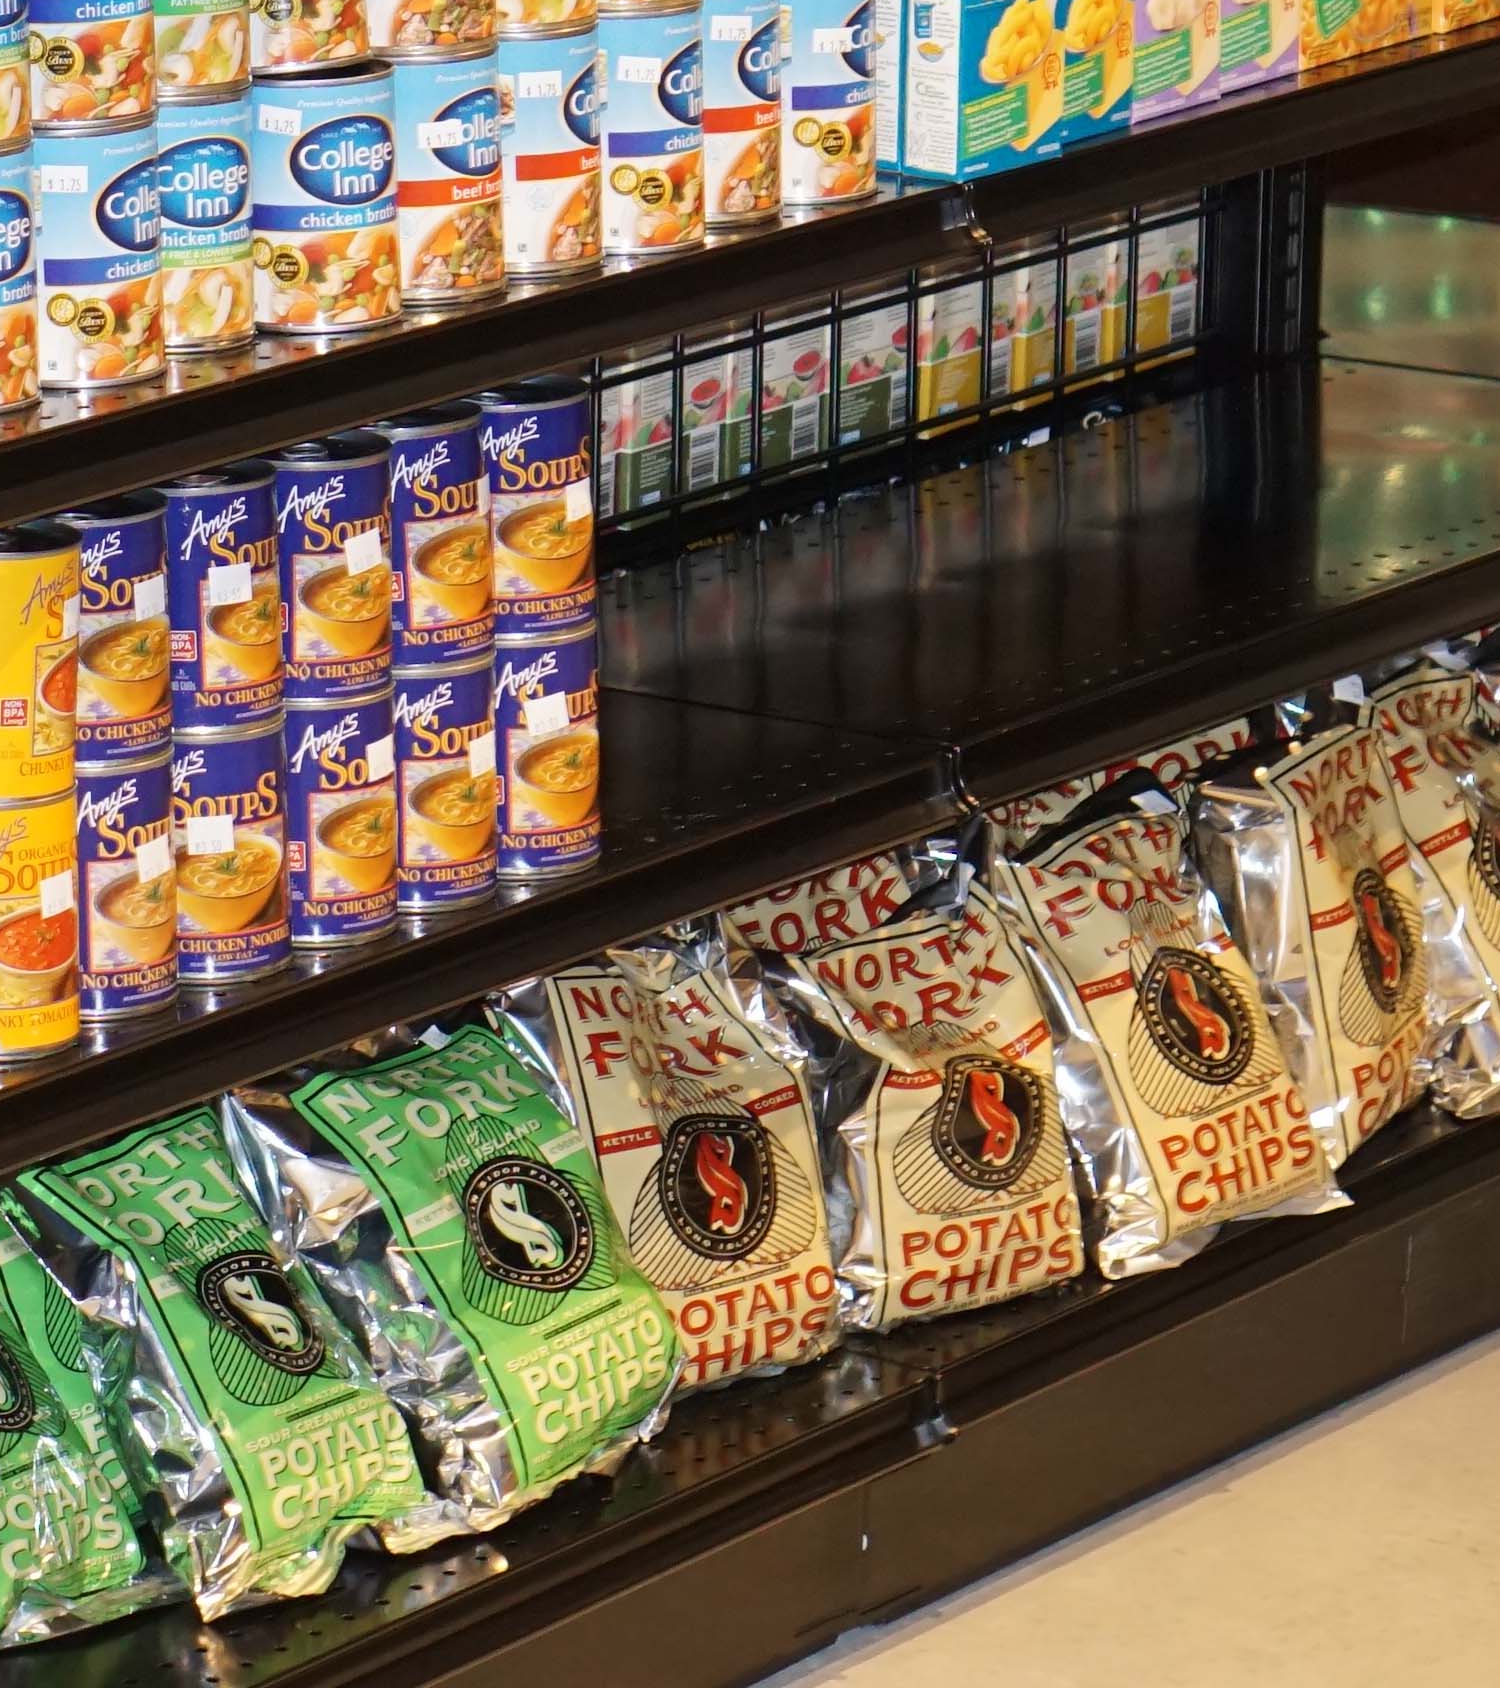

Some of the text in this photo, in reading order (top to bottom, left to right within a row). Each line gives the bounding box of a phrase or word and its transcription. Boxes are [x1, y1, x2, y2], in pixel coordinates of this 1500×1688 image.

[280, 475, 344, 530] Amy's
[403, 622, 487, 646] NO CHICKEN
[321, 1037, 495, 1125] NORTH
[582, 1031, 749, 1080] FORK
[356, 1062, 541, 1167] FORK
[753, 1093, 797, 1110] COOKED
[1160, 1085, 1307, 1172] POTATO
[472, 1116, 541, 1158] ISLAND
[602, 1133, 653, 1150] KETTLE
[1174, 1131, 1317, 1213] CHIPS
[901, 1202, 1072, 1267] POTATO
[898, 1235, 1077, 1308] CHIPS
[520, 1306, 663, 1405] POTATO
[534, 1351, 669, 1447] CHIPS
